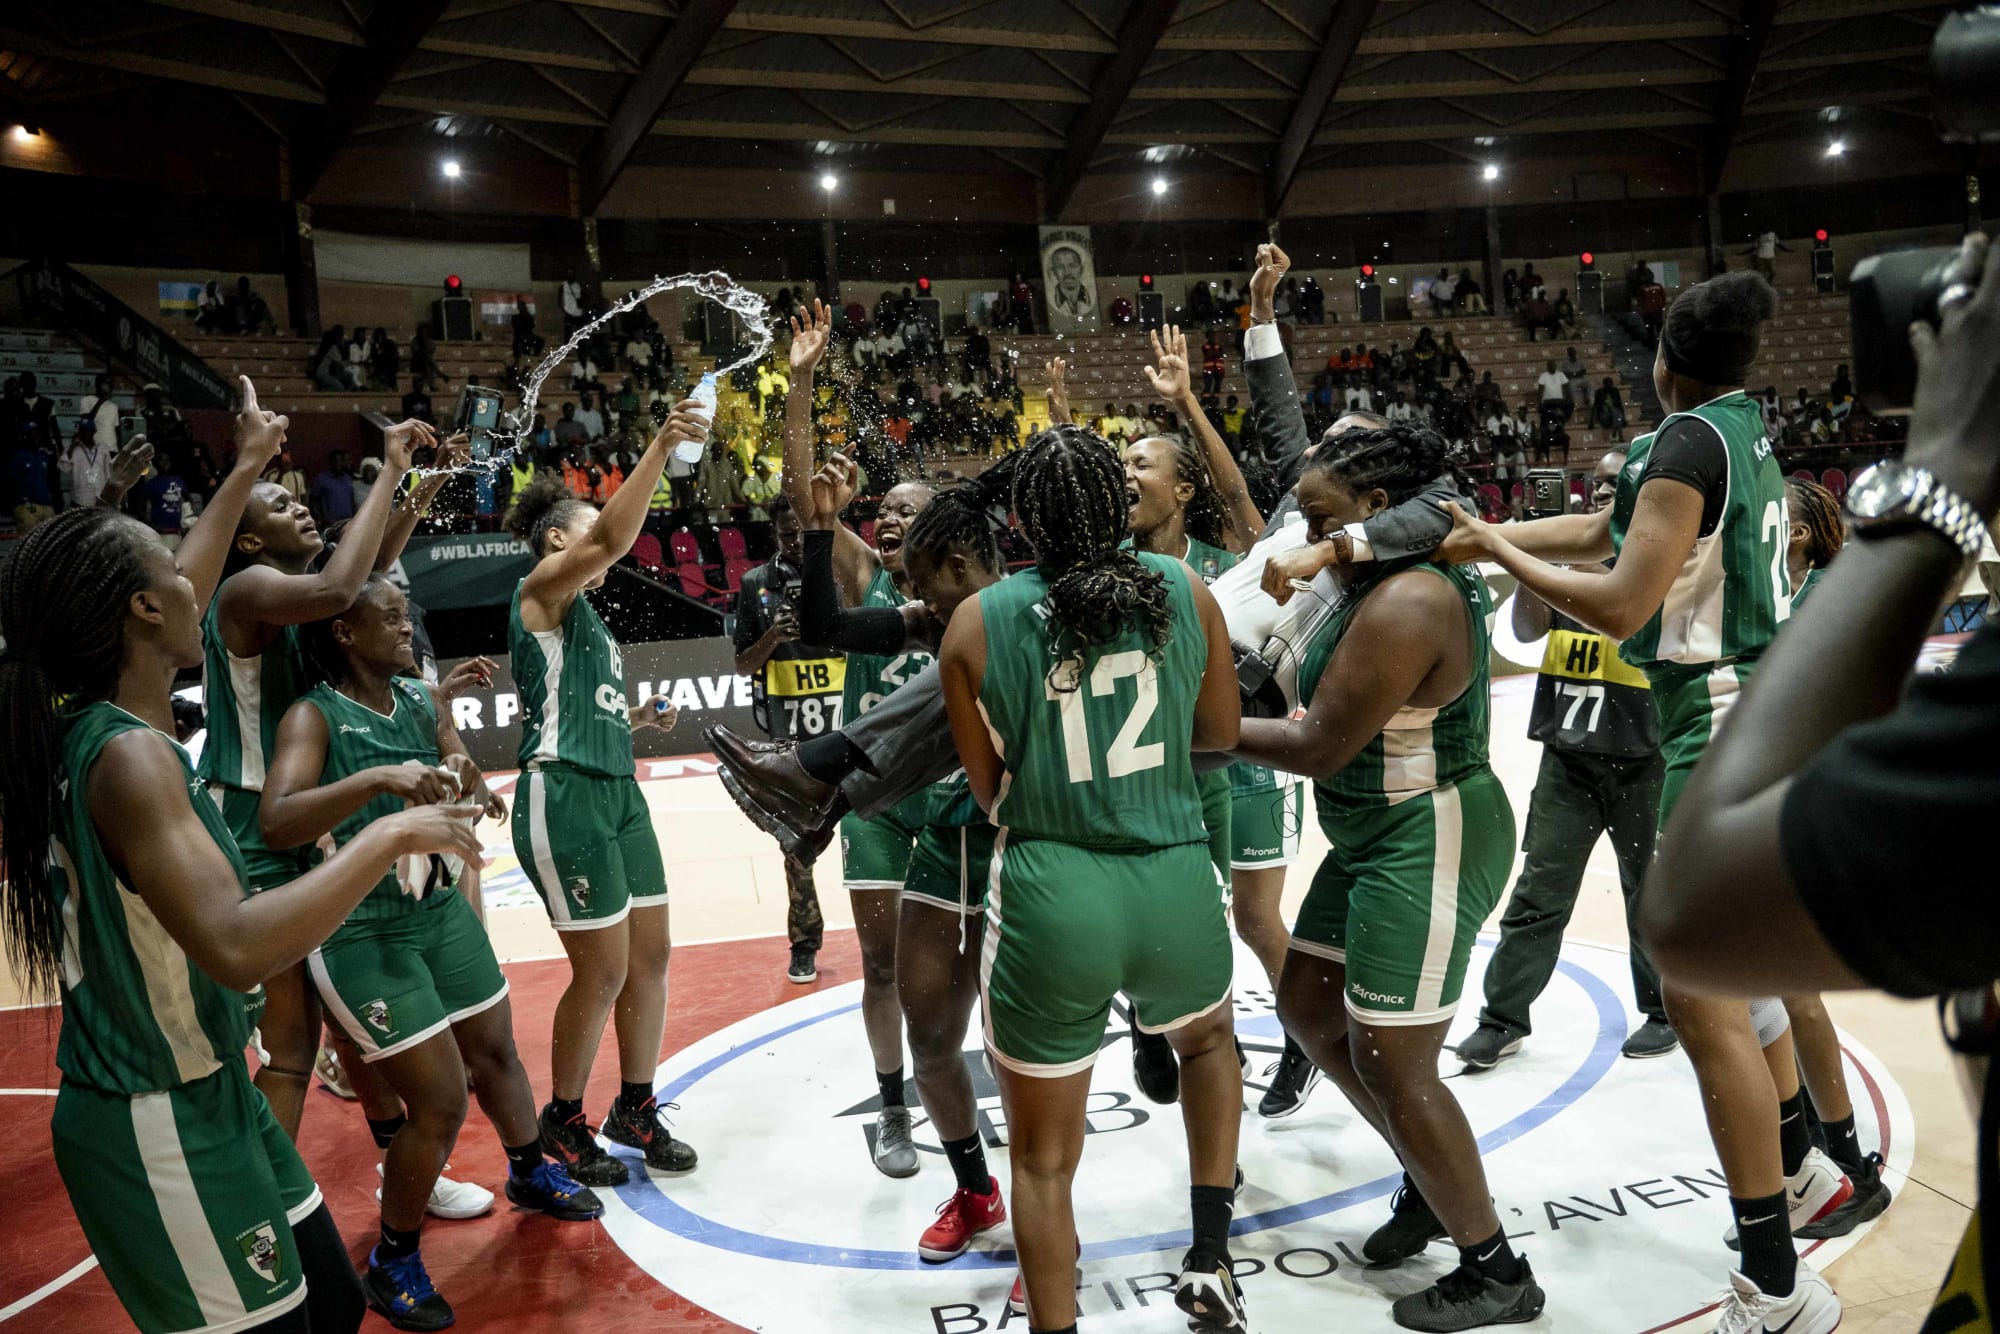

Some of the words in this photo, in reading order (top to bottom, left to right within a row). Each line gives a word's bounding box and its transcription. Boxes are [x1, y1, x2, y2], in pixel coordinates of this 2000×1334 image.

[430, 541, 531, 561] #WBLAFRICA
[1565, 638, 1600, 674] HB
[795, 663, 830, 691] HB
[784, 696, 843, 735] 787
[1044, 650, 1165, 783] 12
[1555, 681, 1605, 733] 77
